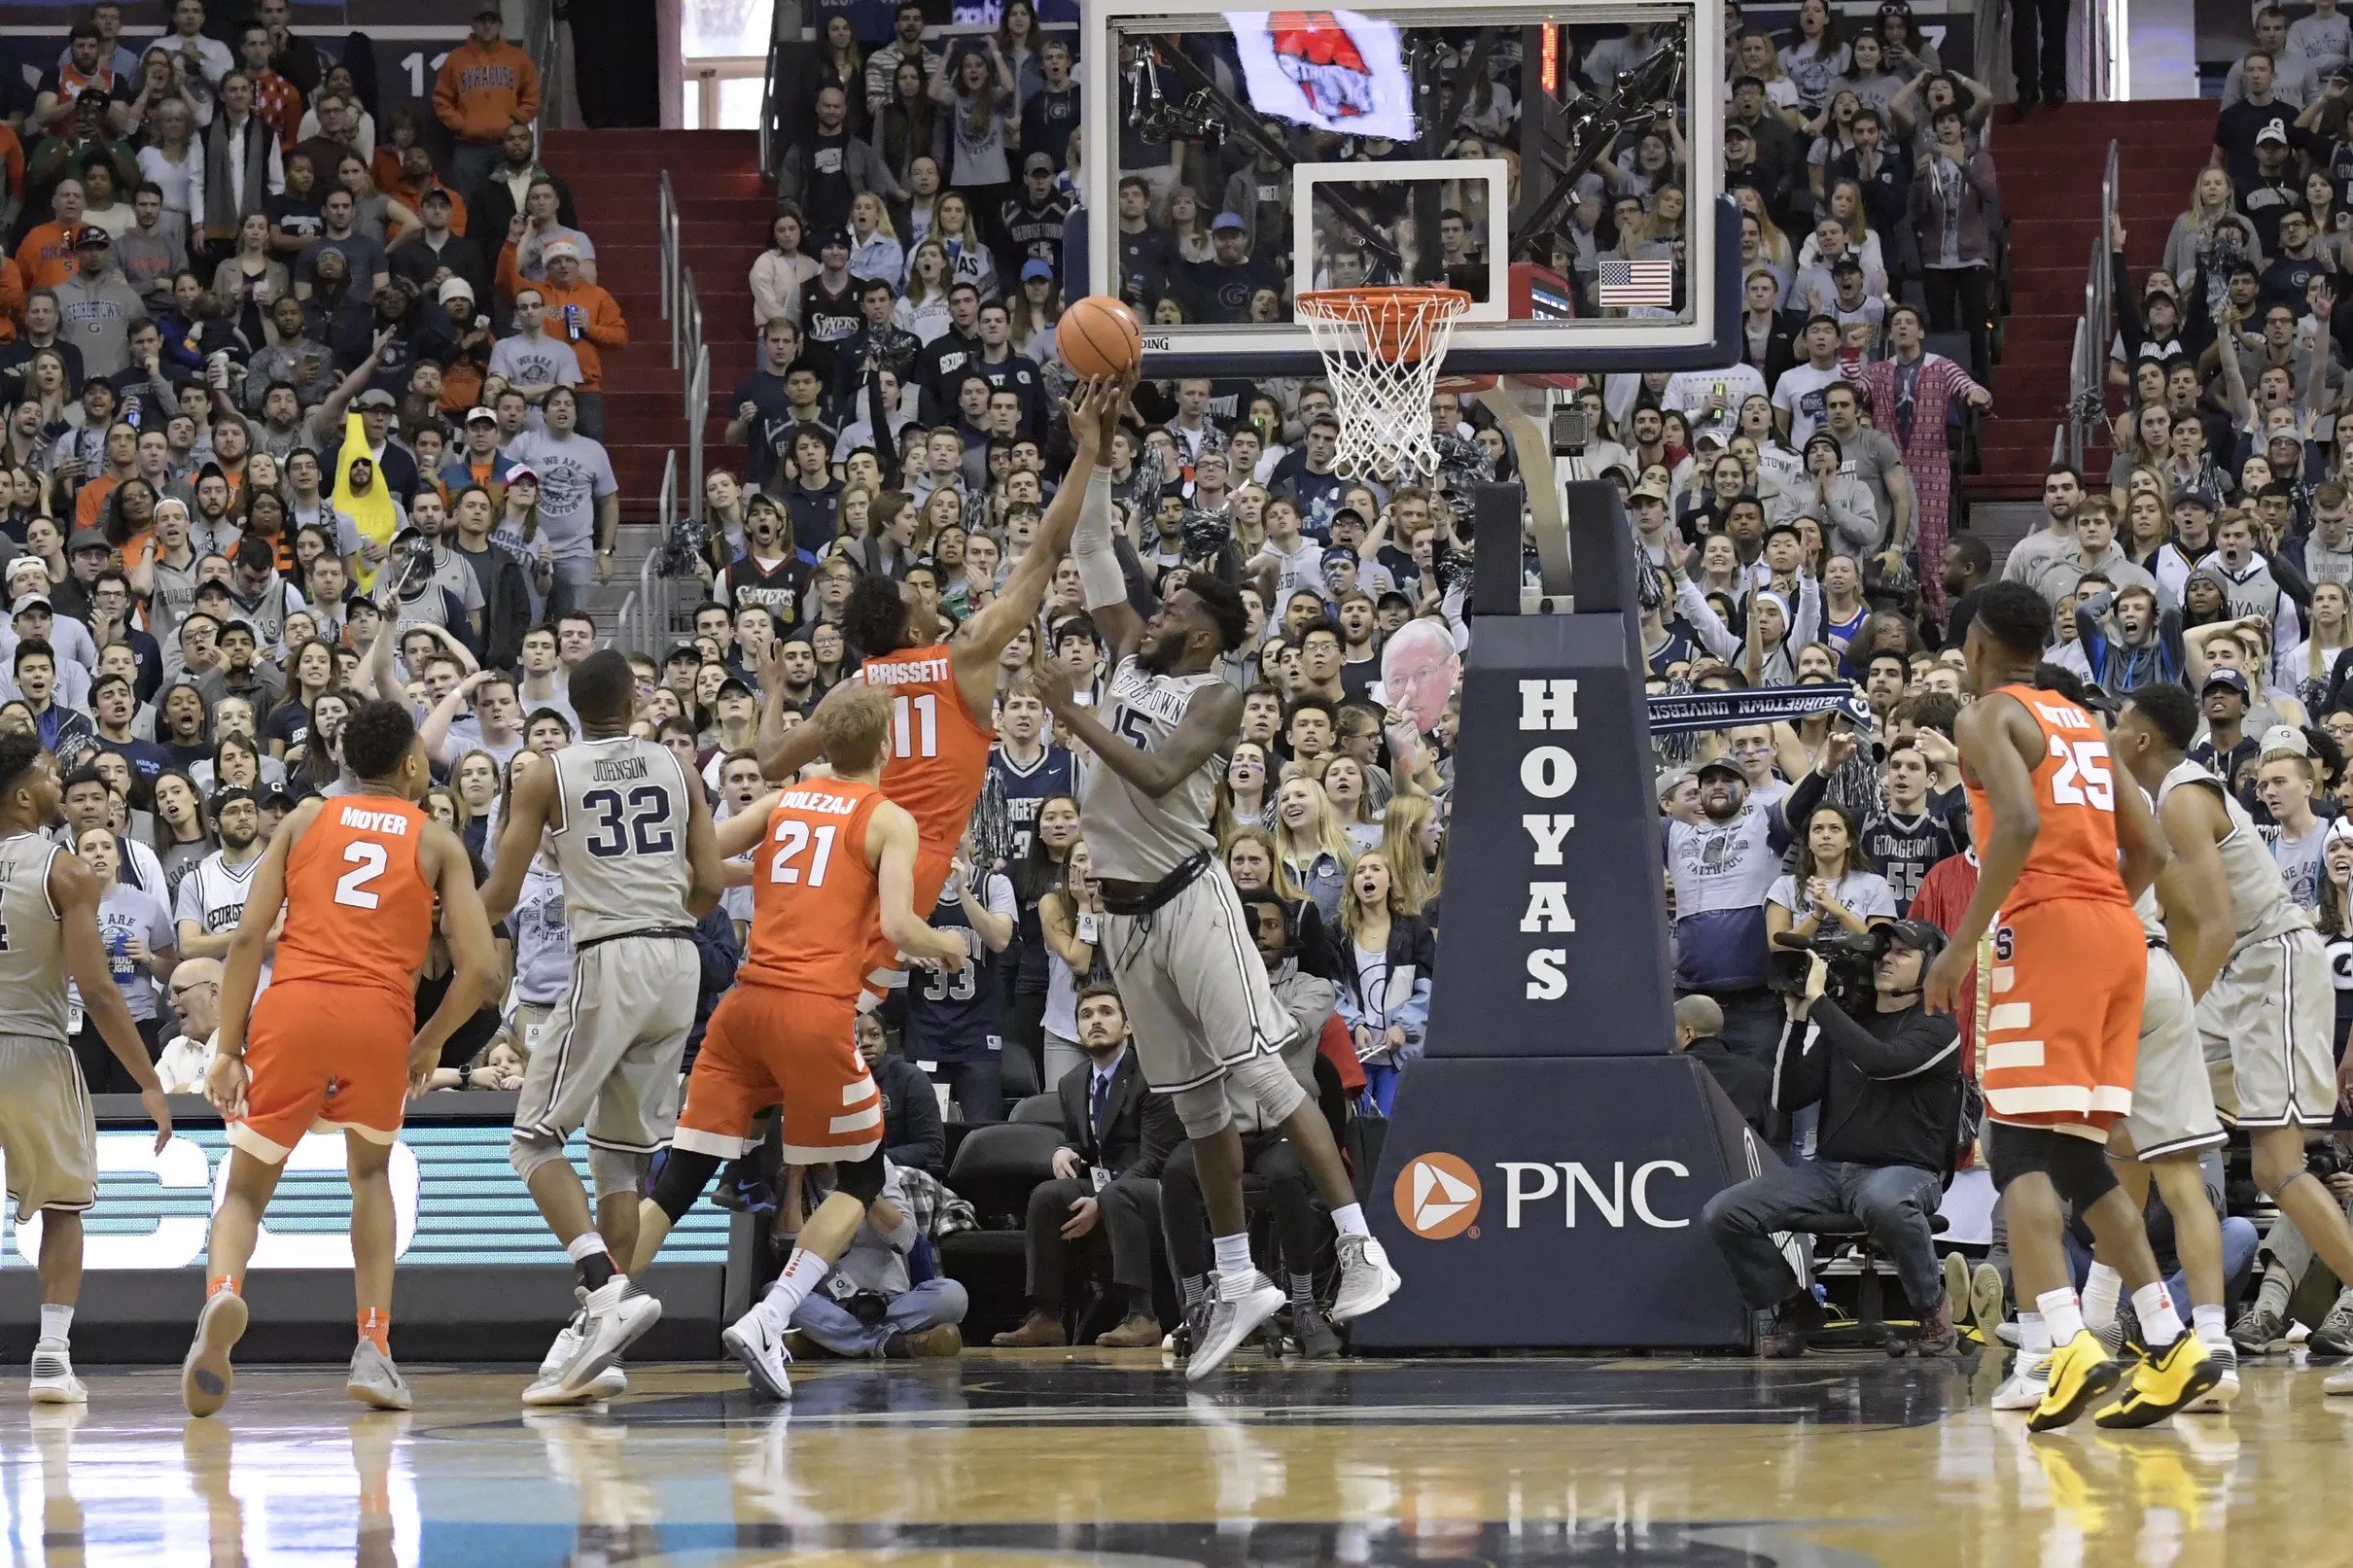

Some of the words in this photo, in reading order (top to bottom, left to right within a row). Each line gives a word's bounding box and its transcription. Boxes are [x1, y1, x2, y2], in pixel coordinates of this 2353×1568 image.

[462, 66, 516, 93] SYRACUSE
[1141, 337, 1169, 351] DING
[543, 456, 559, 466] WE
[866, 660, 948, 685] BRISSETT
[894, 693, 936, 758] 11
[2280, 730, 2291, 739] G
[593, 756, 648, 782] JOHNSON
[2049, 733, 2116, 813] 25
[271, 782, 283, 792] G
[779, 791, 857, 816] DOLEZAJ
[340, 806, 408, 836] MOYER
[581, 784, 675, 858] 32
[770, 819, 837, 888] 21
[1519, 679, 1577, 999] HOYAS
[334, 840, 389, 911] 2
[1887, 862, 1926, 902] 55
[108, 914, 135, 931] ARE
[1996, 926, 2014, 961] S
[925, 957, 975, 1000] 33
[1494, 1160, 1691, 1229] PNC
